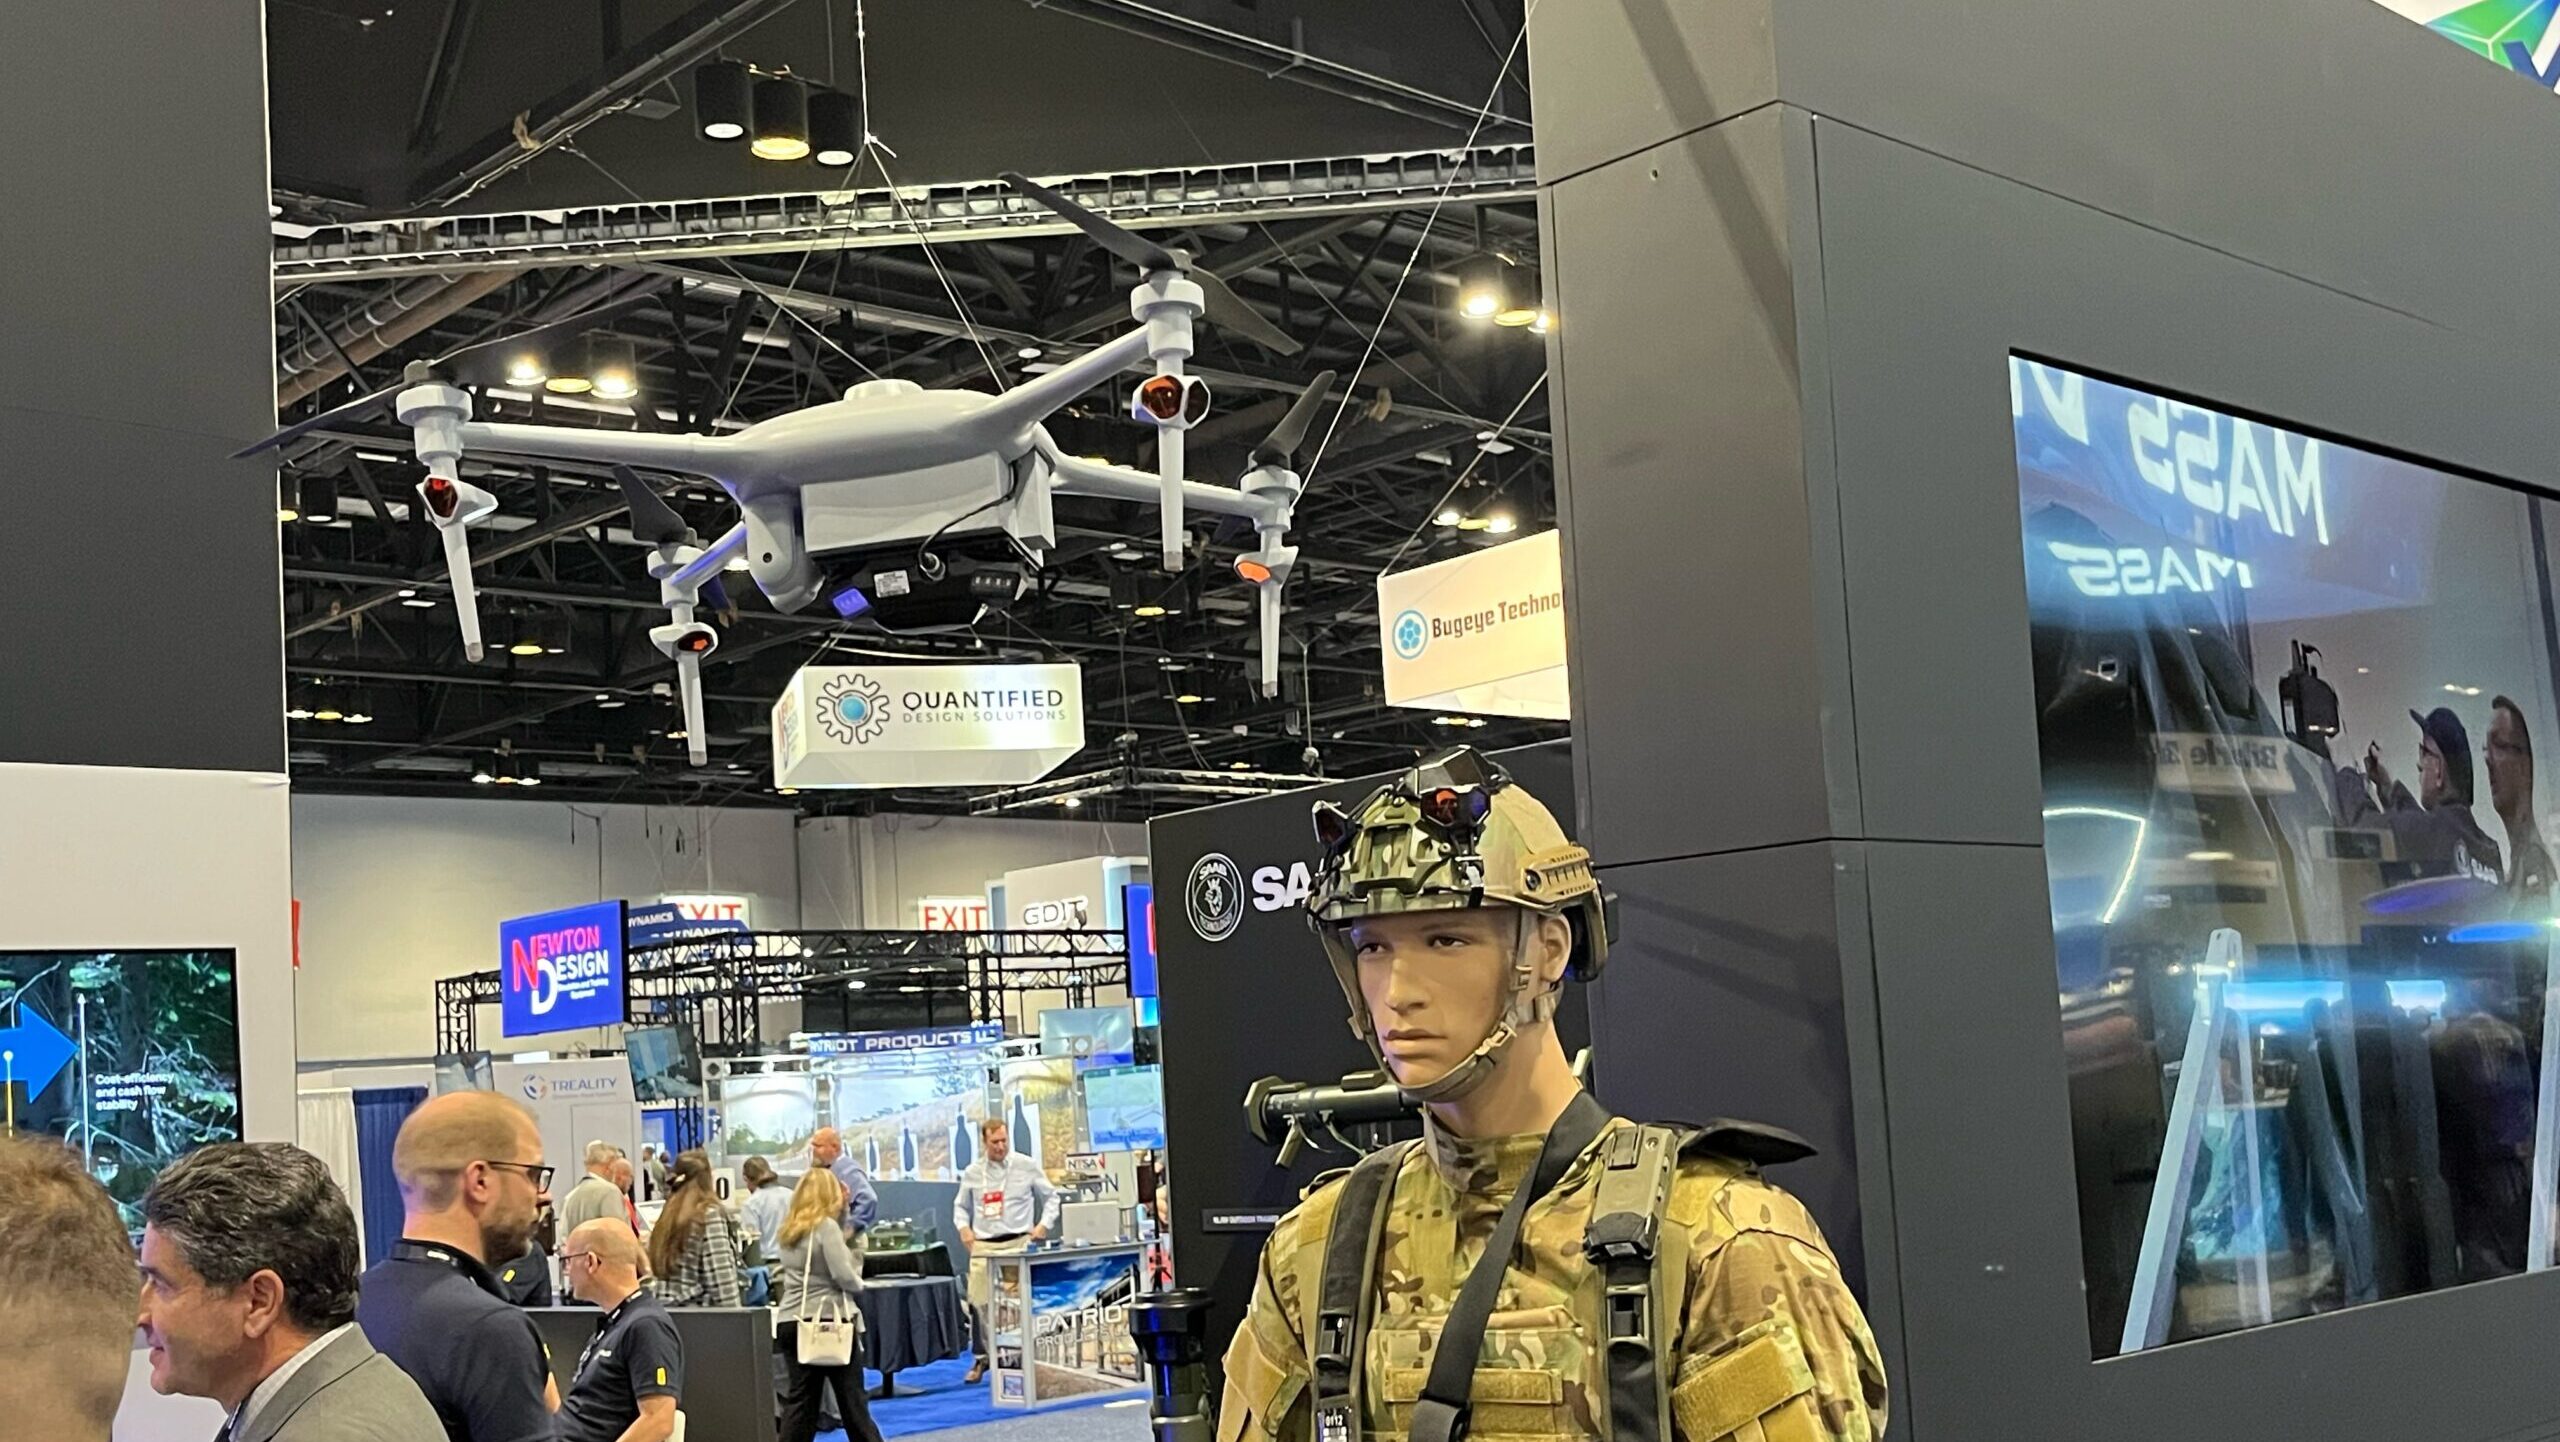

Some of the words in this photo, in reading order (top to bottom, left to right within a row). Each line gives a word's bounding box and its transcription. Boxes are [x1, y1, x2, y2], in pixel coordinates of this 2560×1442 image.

[1432, 609, 1495, 639] Bugeye
[1498, 592, 1561, 623] Techno
[902, 689, 1063, 712] QUANTIFIED
[903, 711, 964, 724] DESIGN
[973, 709, 1066, 722] SOLUTIONS
[1199, 862, 1228, 880] SAAB
[1252, 860, 1313, 912] SA
[676, 903, 742, 921] XIT
[924, 906, 988, 931] EXIT
[1023, 899, 1084, 925] GDIT
[512, 925, 600, 992] NEWTON
[531, 949, 609, 1015] DESIGN
[865, 1030, 971, 1050] PRODUCTS
[95, 1072, 174, 1085] Cost-efficiency
[551, 1077, 617, 1092] TREALITY
[95, 1086, 117, 1098] and
[117, 1085, 142, 1096] cash
[143, 1084, 167, 1096] flow
[95, 1099, 138, 1111] stability
